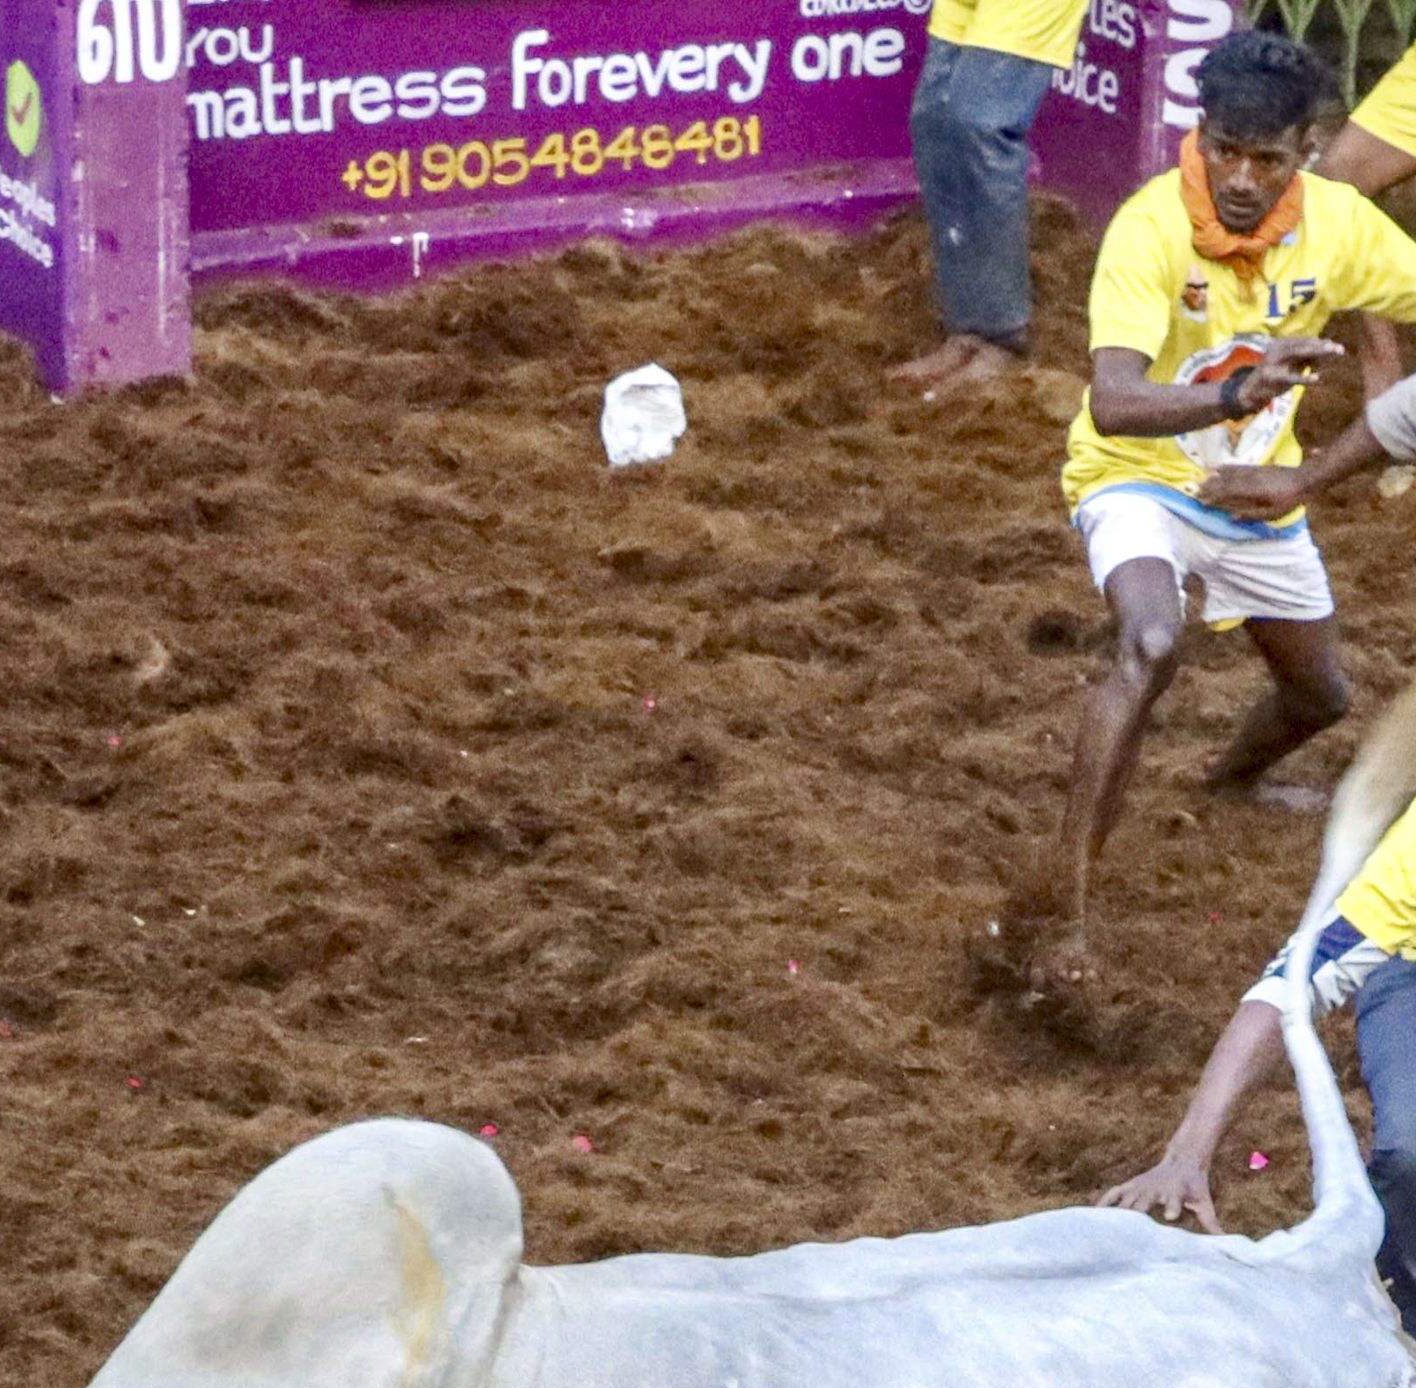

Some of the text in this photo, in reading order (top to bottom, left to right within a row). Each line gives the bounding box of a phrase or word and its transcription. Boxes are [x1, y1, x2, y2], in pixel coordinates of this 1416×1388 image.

[186, 57, 486, 139] mattress
[791, 27, 905, 82] one
[1052, 40, 1120, 114] oice
